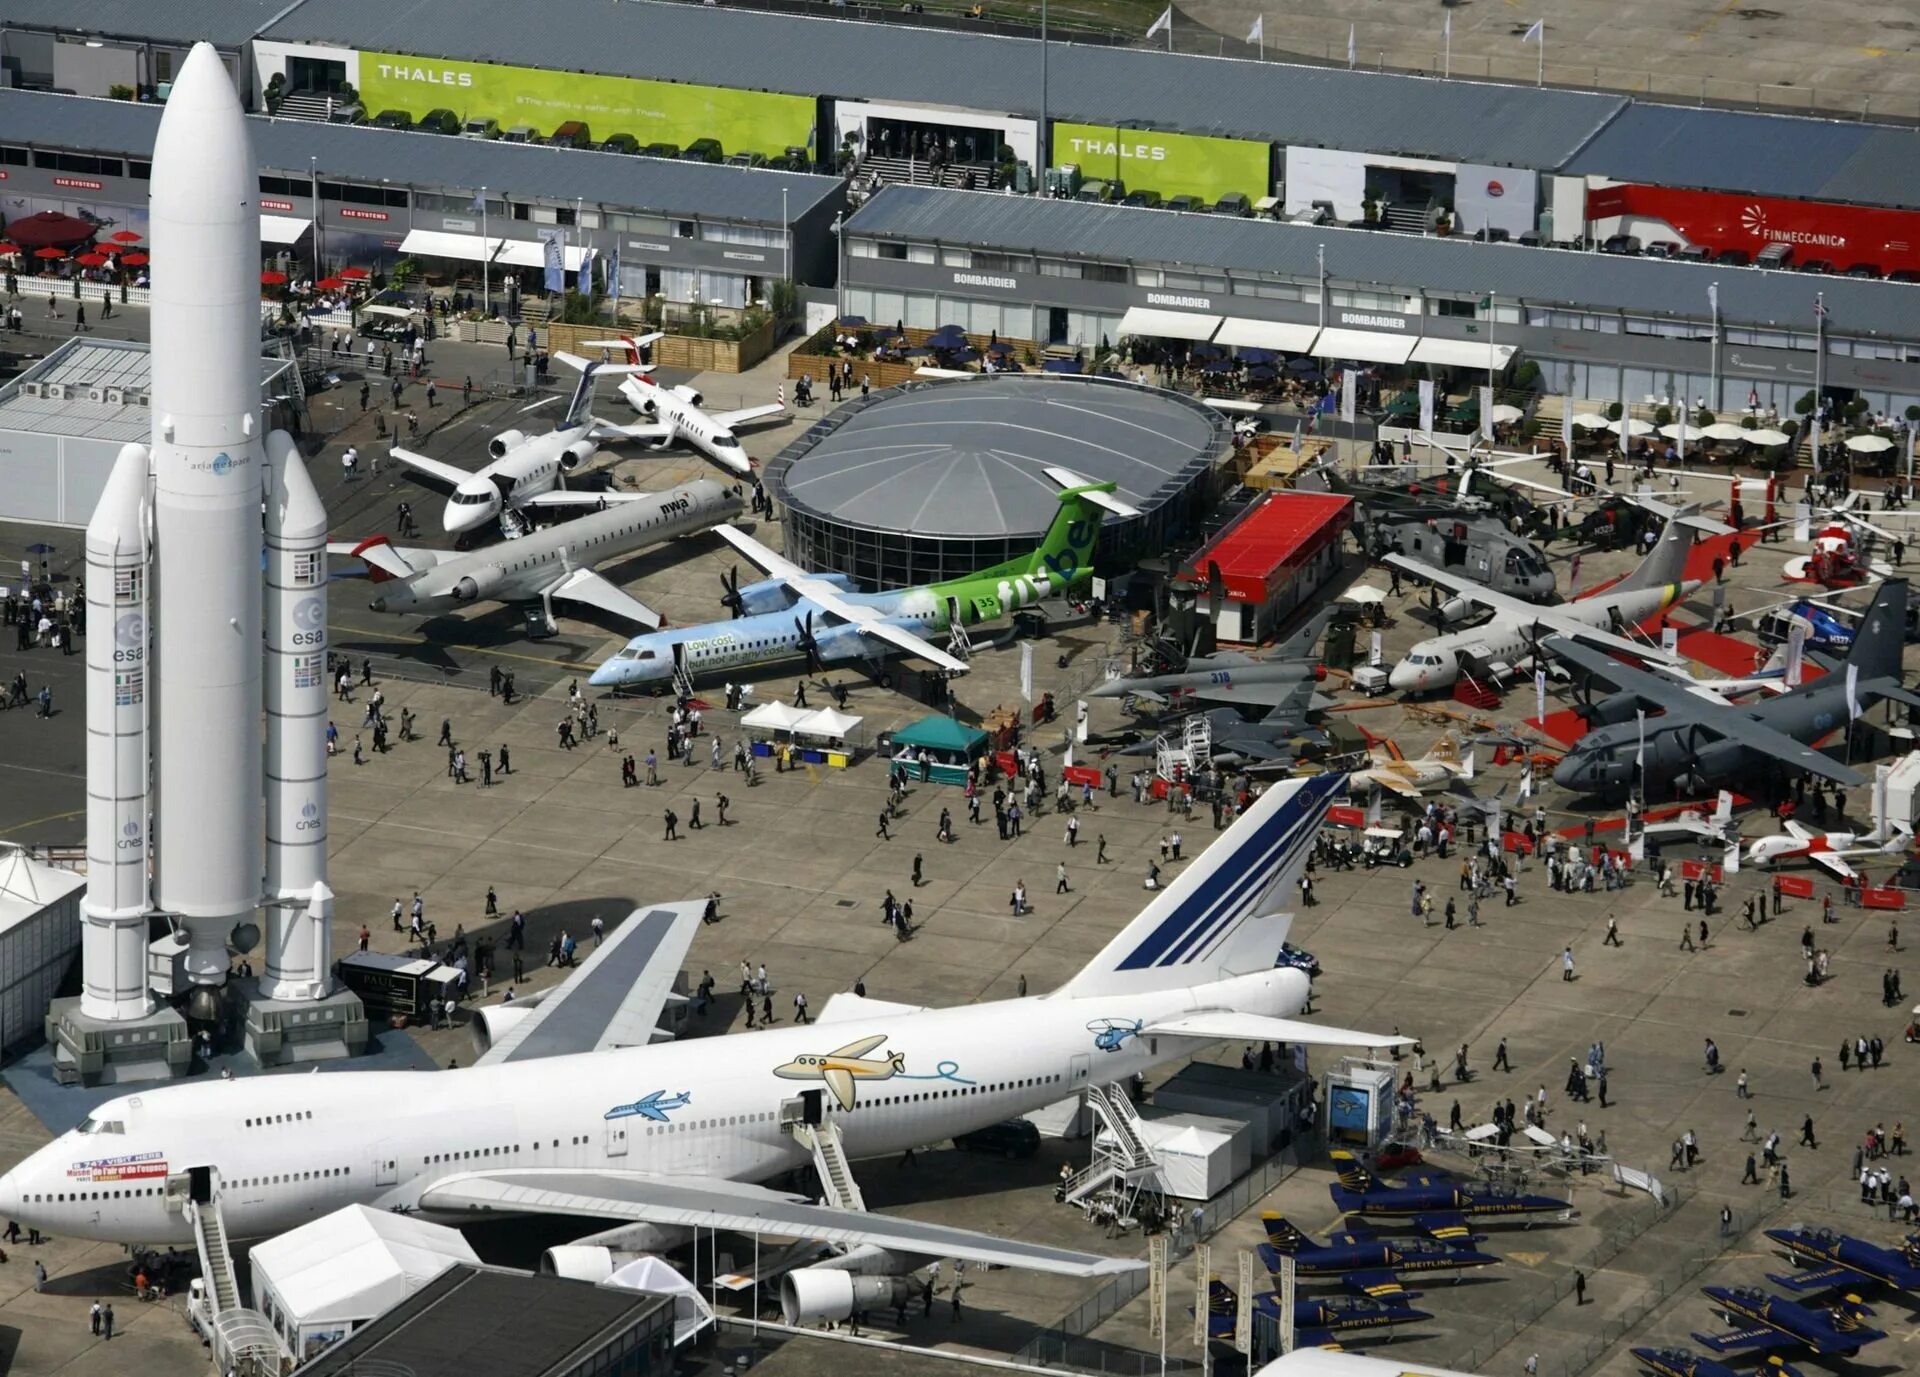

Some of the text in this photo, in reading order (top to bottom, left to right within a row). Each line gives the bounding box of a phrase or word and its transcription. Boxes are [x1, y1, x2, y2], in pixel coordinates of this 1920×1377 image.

[378, 64, 472, 87] THALES
[1070, 138, 1165, 161] THALES
[70, 180, 100, 189] SYSTEMS
[261, 201, 291, 210] SYSTEMS
[357, 211, 387, 220] SYSTEMS
[1763, 228, 1845, 247] FINMECCANICA
[953, 273, 1016, 289] BOMBARDIER
[1147, 293, 1210, 309] BOMBARDIER
[1341, 312, 1405, 329] BOMBARDIER
[660, 498, 689, 515] nwa
[978, 597, 995, 608] 35
[292, 629, 324, 646] esa
[112, 647, 144, 663] esa
[688, 645, 785, 669] but not at any cost
[1211, 671, 1231, 684] 318
[295, 818, 321, 831] cnes
[117, 836, 144, 849] cnes
[363, 974, 394, 988] PAUL
[84, 1160, 103, 1169] 747
[107, 1156, 132, 1165] VISIT
[135, 1152, 162, 1161] HERE
[92, 1167, 102, 1176] de
[118, 1166, 126, 1174] et
[127, 1165, 136, 1174] de
[1473, 1203, 1523, 1212] BREITLING
[1404, 1259, 1454, 1269] BREITLING
[1794, 1267, 1845, 1283] BREITLING
[1341, 1316, 1390, 1327] BREITLING
[1718, 1328, 1772, 1344] BREITLING
